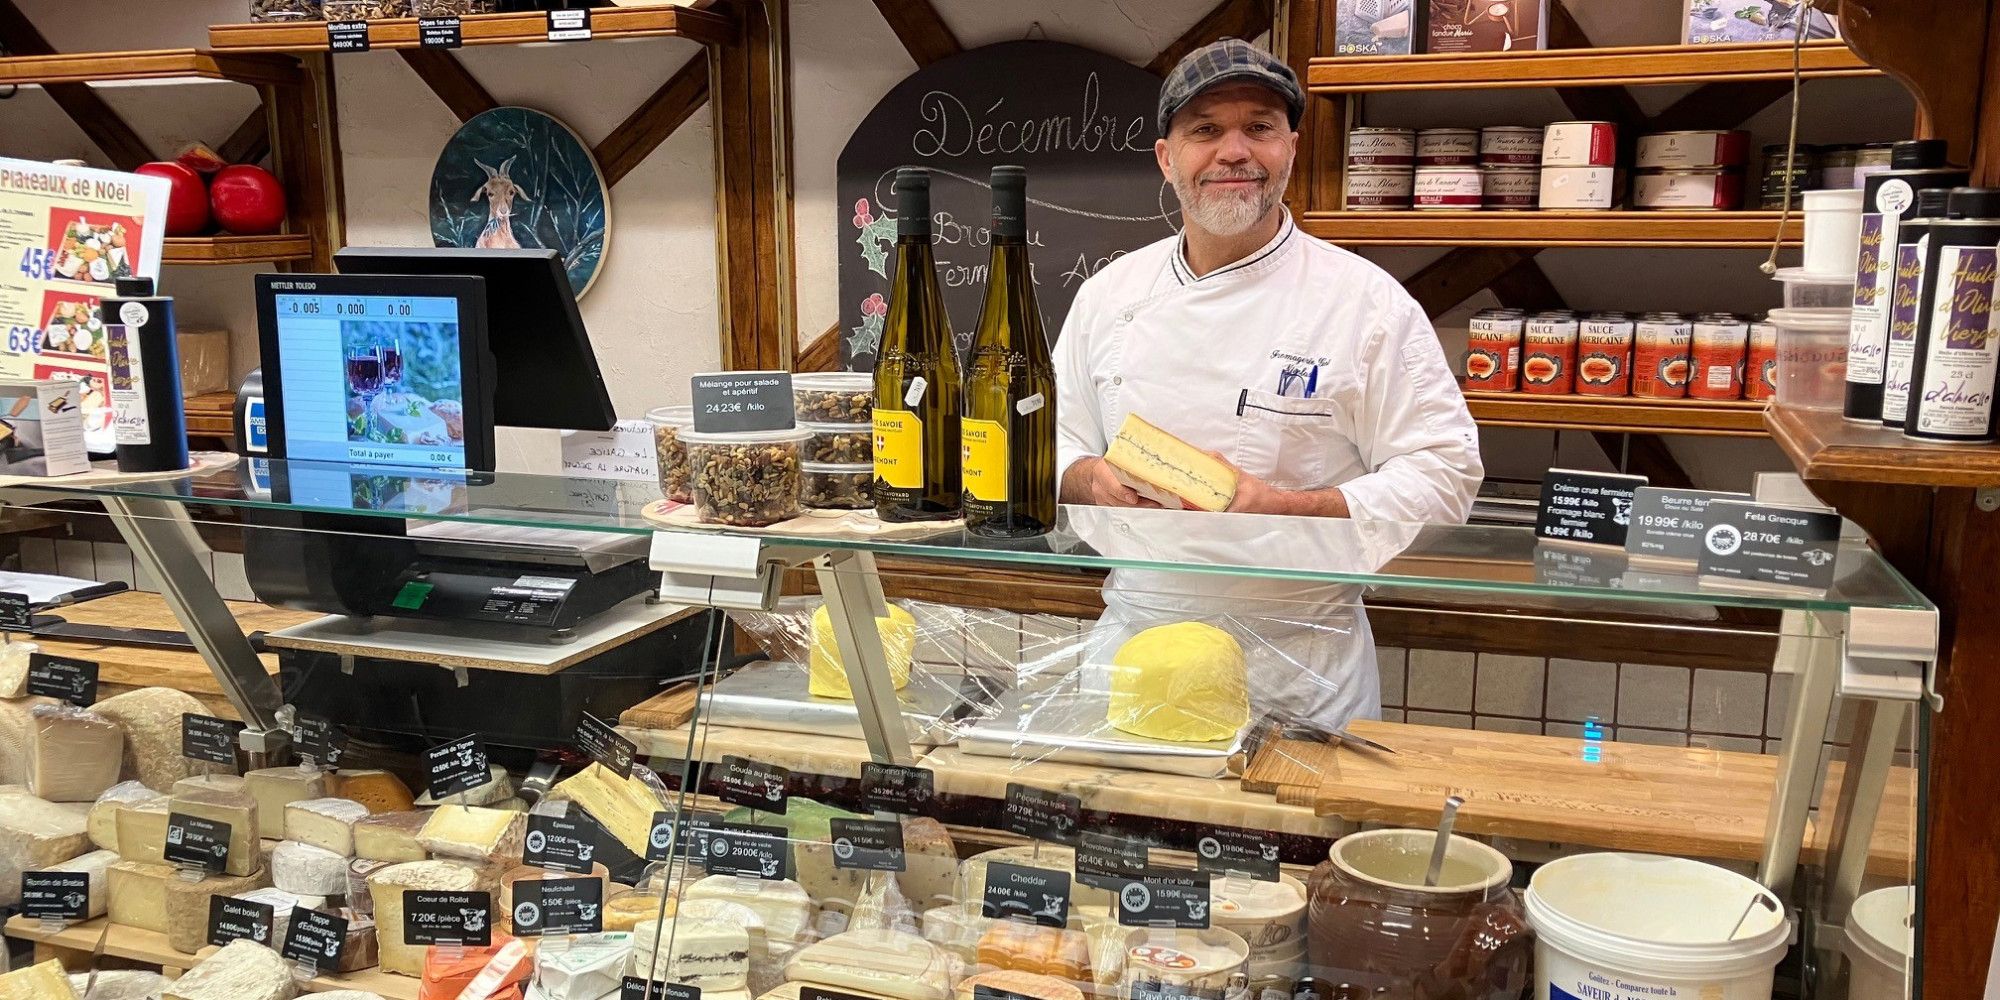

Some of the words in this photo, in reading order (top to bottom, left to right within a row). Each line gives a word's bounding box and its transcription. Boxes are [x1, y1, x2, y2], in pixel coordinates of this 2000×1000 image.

[1693, 35, 1731, 44] BOSKA
[1338, 44, 1378, 54] BOSKA
[914, 72, 1154, 156] Décembre
[72, 178, 91, 196] de
[20, 247, 55, 280] 45€
[1950, 254, 2000, 290] Huile
[271, 282, 294, 290] METTLER
[337, 304, 365, 315] 0.000
[388, 304, 411, 316] 0.00
[1472, 321, 1494, 331] SAUCE
[1531, 324, 1554, 334] SAUCE
[1588, 324, 1614, 334] SAUCE
[9, 326, 43, 353] 63€
[700, 381, 733, 389] Mélange
[734, 380, 752, 388] pour
[732, 388, 759, 396] apéritif
[747, 403, 765, 411] /kilo
[879, 421, 903, 429] SAVOIE
[966, 430, 987, 438] SAVOIE
[350, 449, 367, 458] Total
[374, 451, 394, 461] payer
[1553, 483, 1580, 494] Crème
[1581, 487, 1599, 495] crue
[1600, 488, 1634, 498] fermière
[1661, 496, 1693, 506] Beurre
[1546, 506, 1582, 518] Fromage
[1583, 510, 1606, 520] blanc
[1681, 520, 1704, 530] /kilo
[1745, 512, 1766, 522] Feta
[1768, 514, 1809, 527] Grecque
[1573, 528, 1594, 539] /kilo
[730, 764, 753, 776] Gouda
[1215, 829, 1230, 837] Mont
[1010, 873, 1047, 886] Cheddar
[1144, 876, 1162, 885] Mont
[1163, 877, 1176, 885] d'or
[1178, 877, 1195, 887] baby
[449, 896, 469, 904] Rollot
[224, 904, 242, 915] Galet
[242, 908, 260, 918] boisé
[310, 913, 330, 926] Trappe
[438, 915, 461, 924] /pièce
[1589, 972, 1610, 985] Goûtez
[1615, 979, 1650, 994] Comparez
[1650, 987, 1668, 996] toute
[1670, 987, 1677, 996] la
